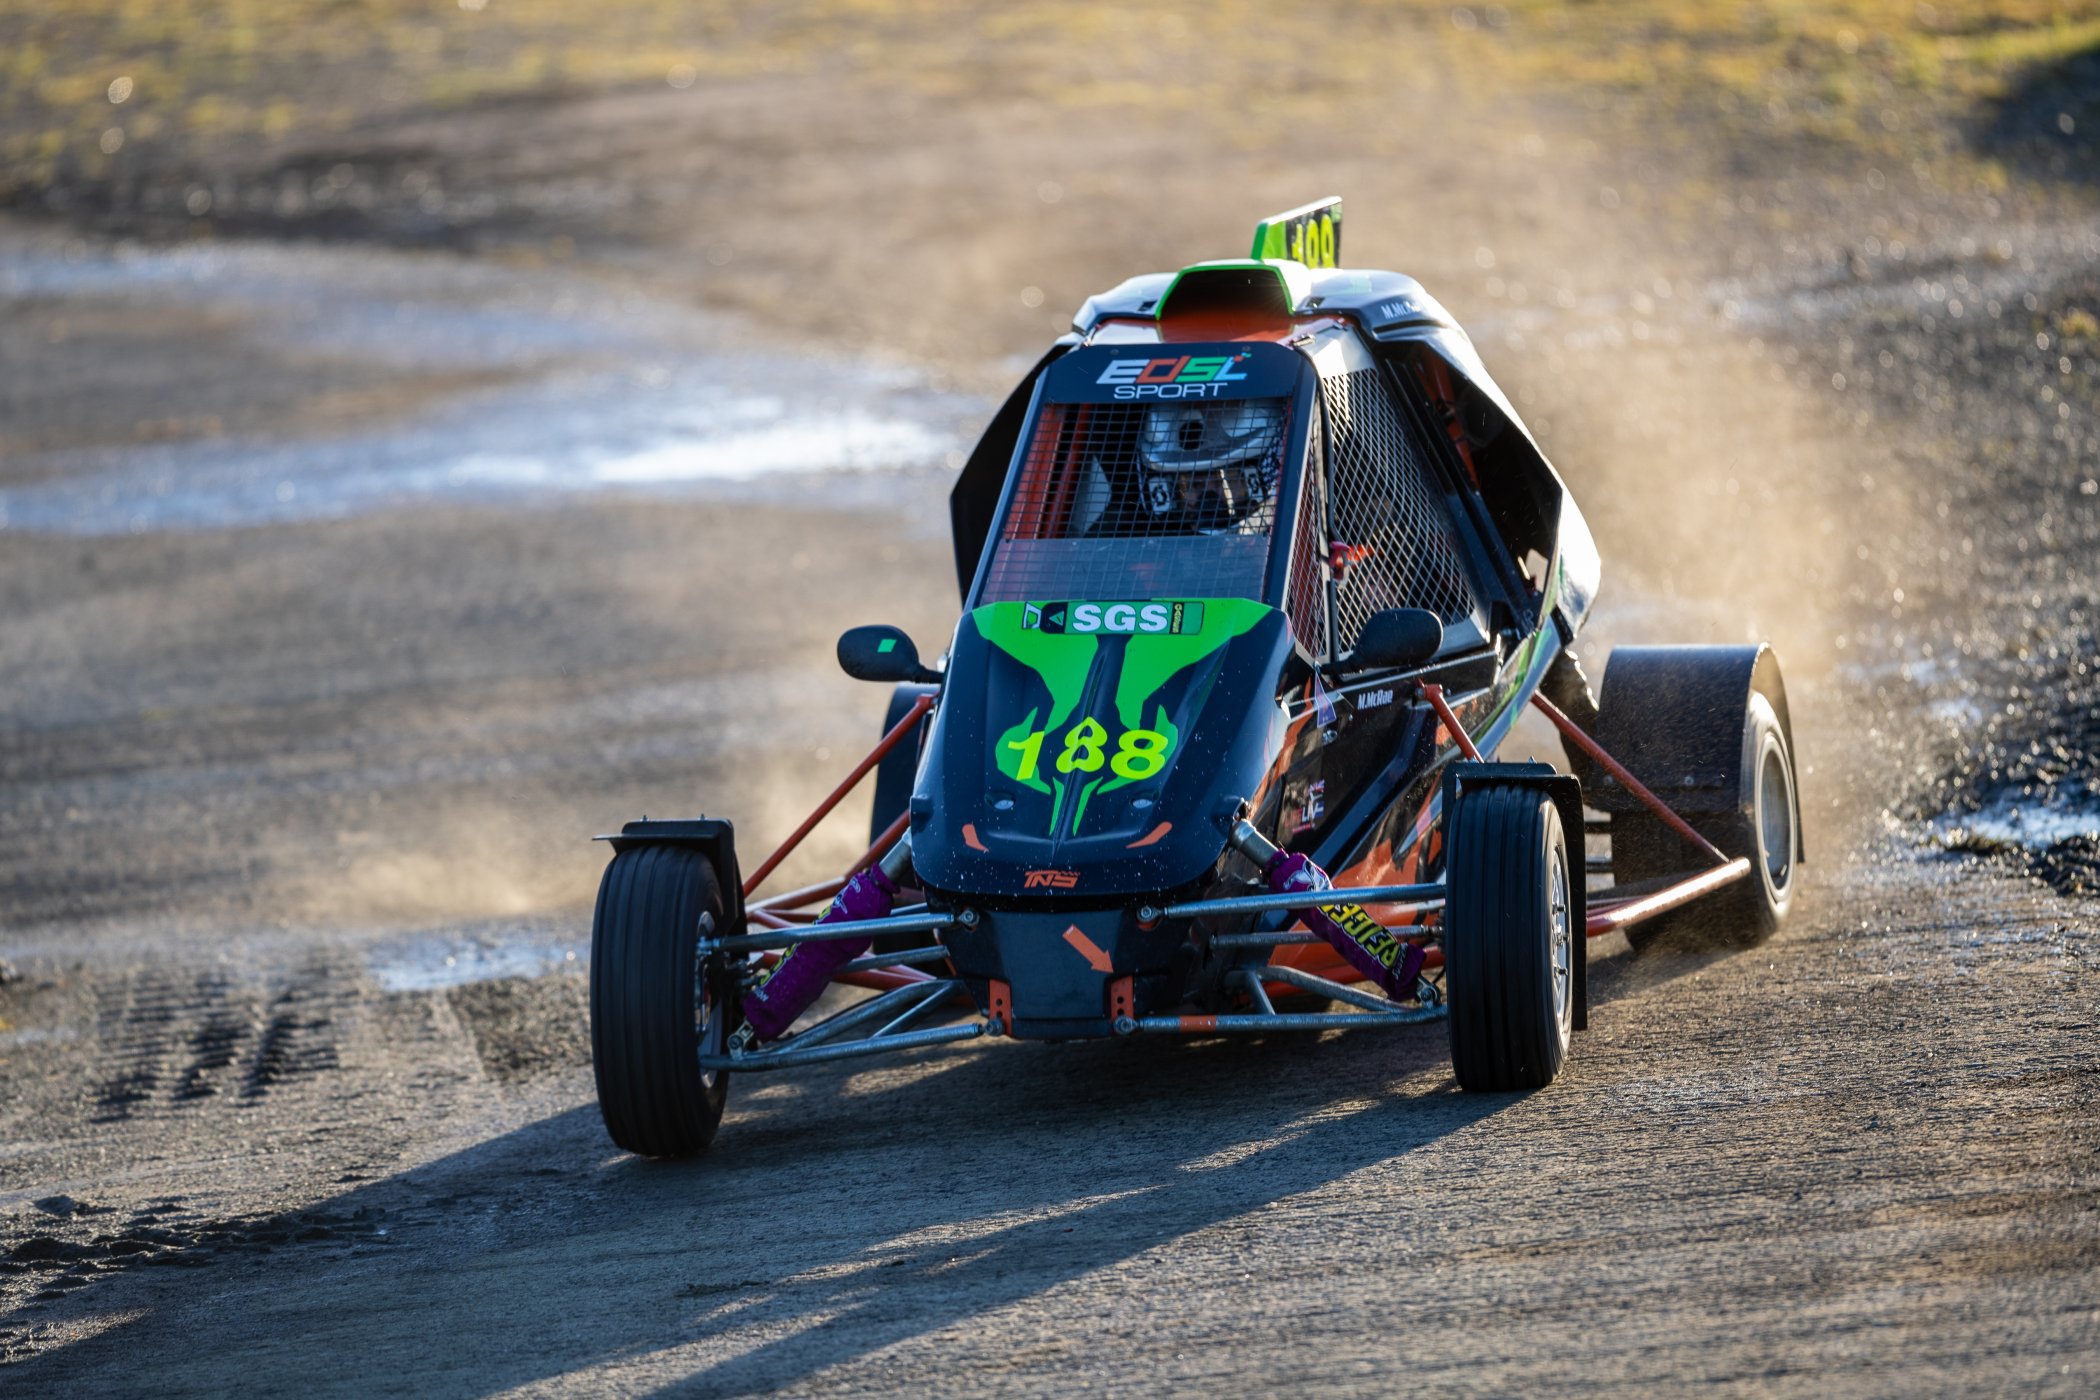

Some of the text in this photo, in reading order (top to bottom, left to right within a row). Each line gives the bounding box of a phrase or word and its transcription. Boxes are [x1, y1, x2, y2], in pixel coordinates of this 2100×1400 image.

[1113, 383, 1228, 399] SPORT
[1072, 604, 1168, 631] SGS
[1008, 716, 1168, 780] 188
